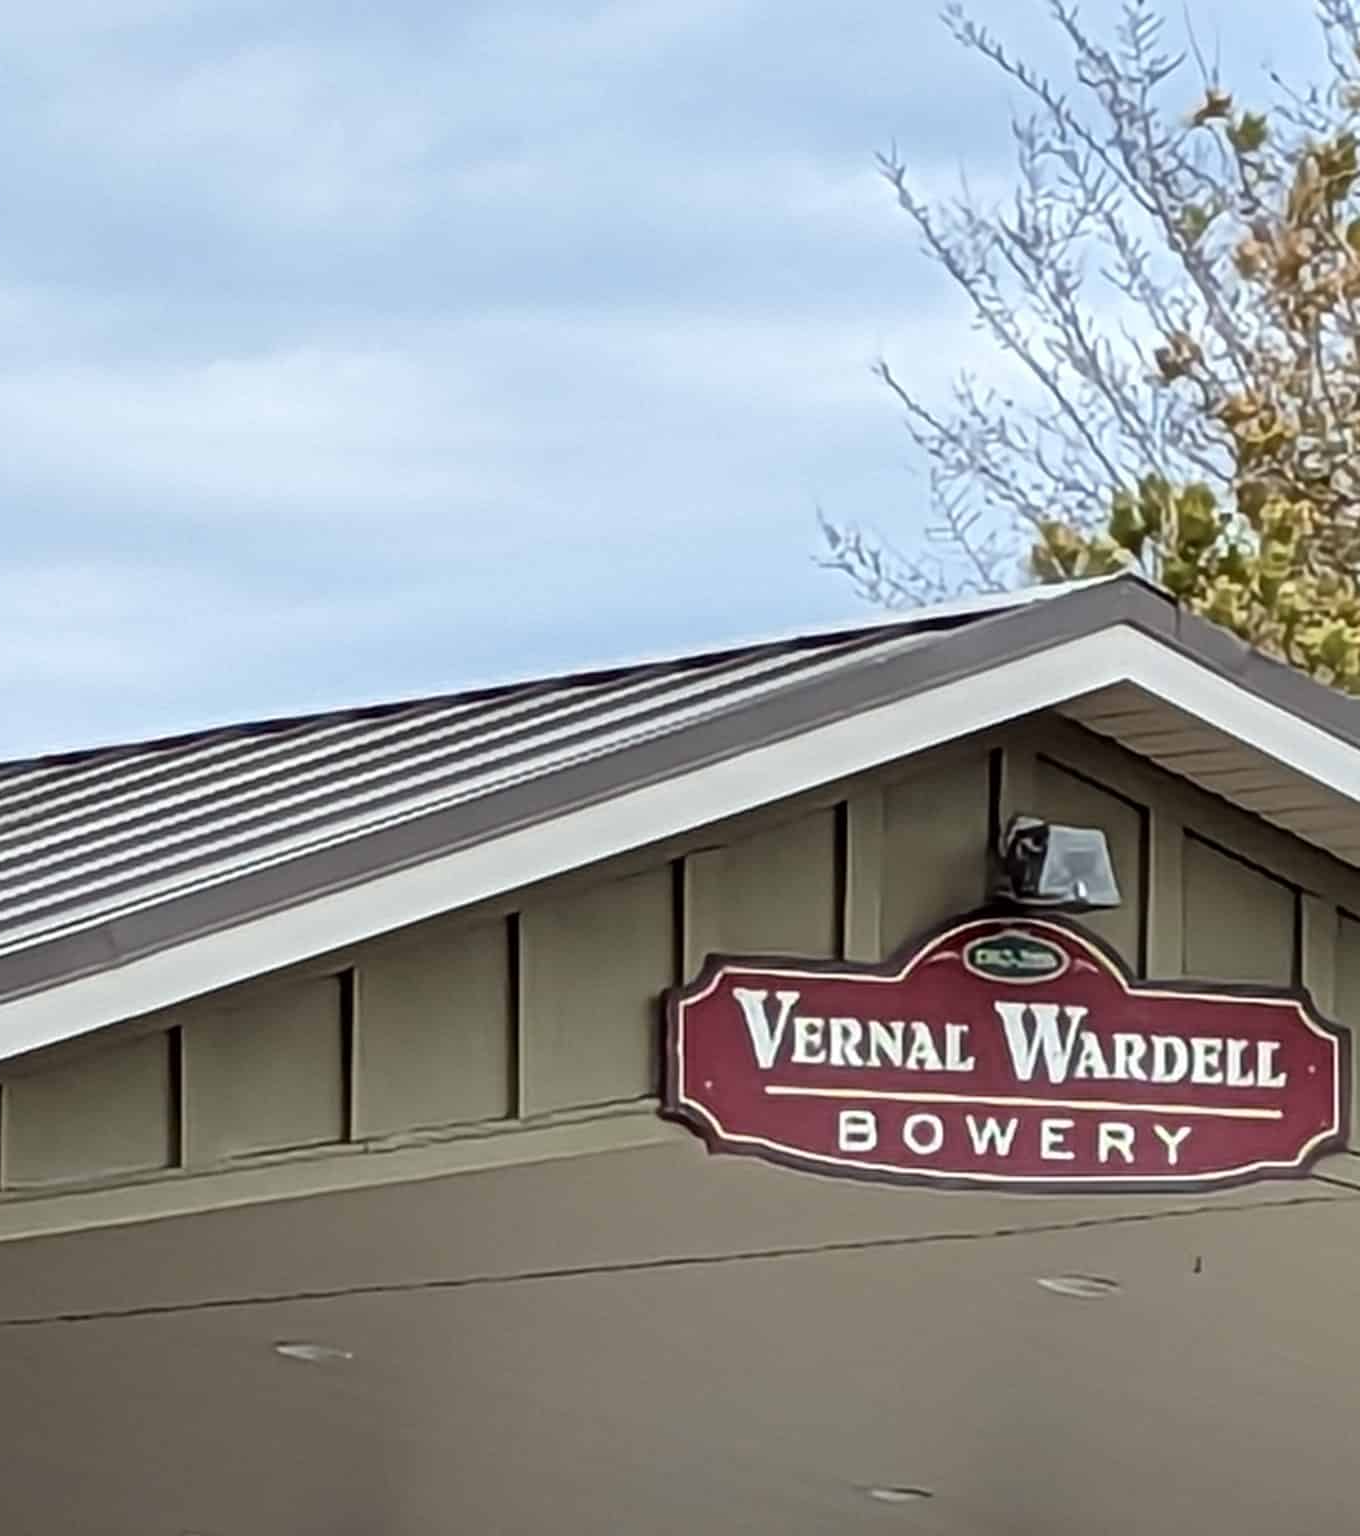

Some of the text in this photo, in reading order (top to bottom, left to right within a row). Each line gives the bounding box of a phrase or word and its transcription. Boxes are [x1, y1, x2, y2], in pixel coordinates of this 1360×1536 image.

[732, 987, 1288, 1088] VERNAL WARDELL
[837, 1110, 1193, 1166] BOWERY
